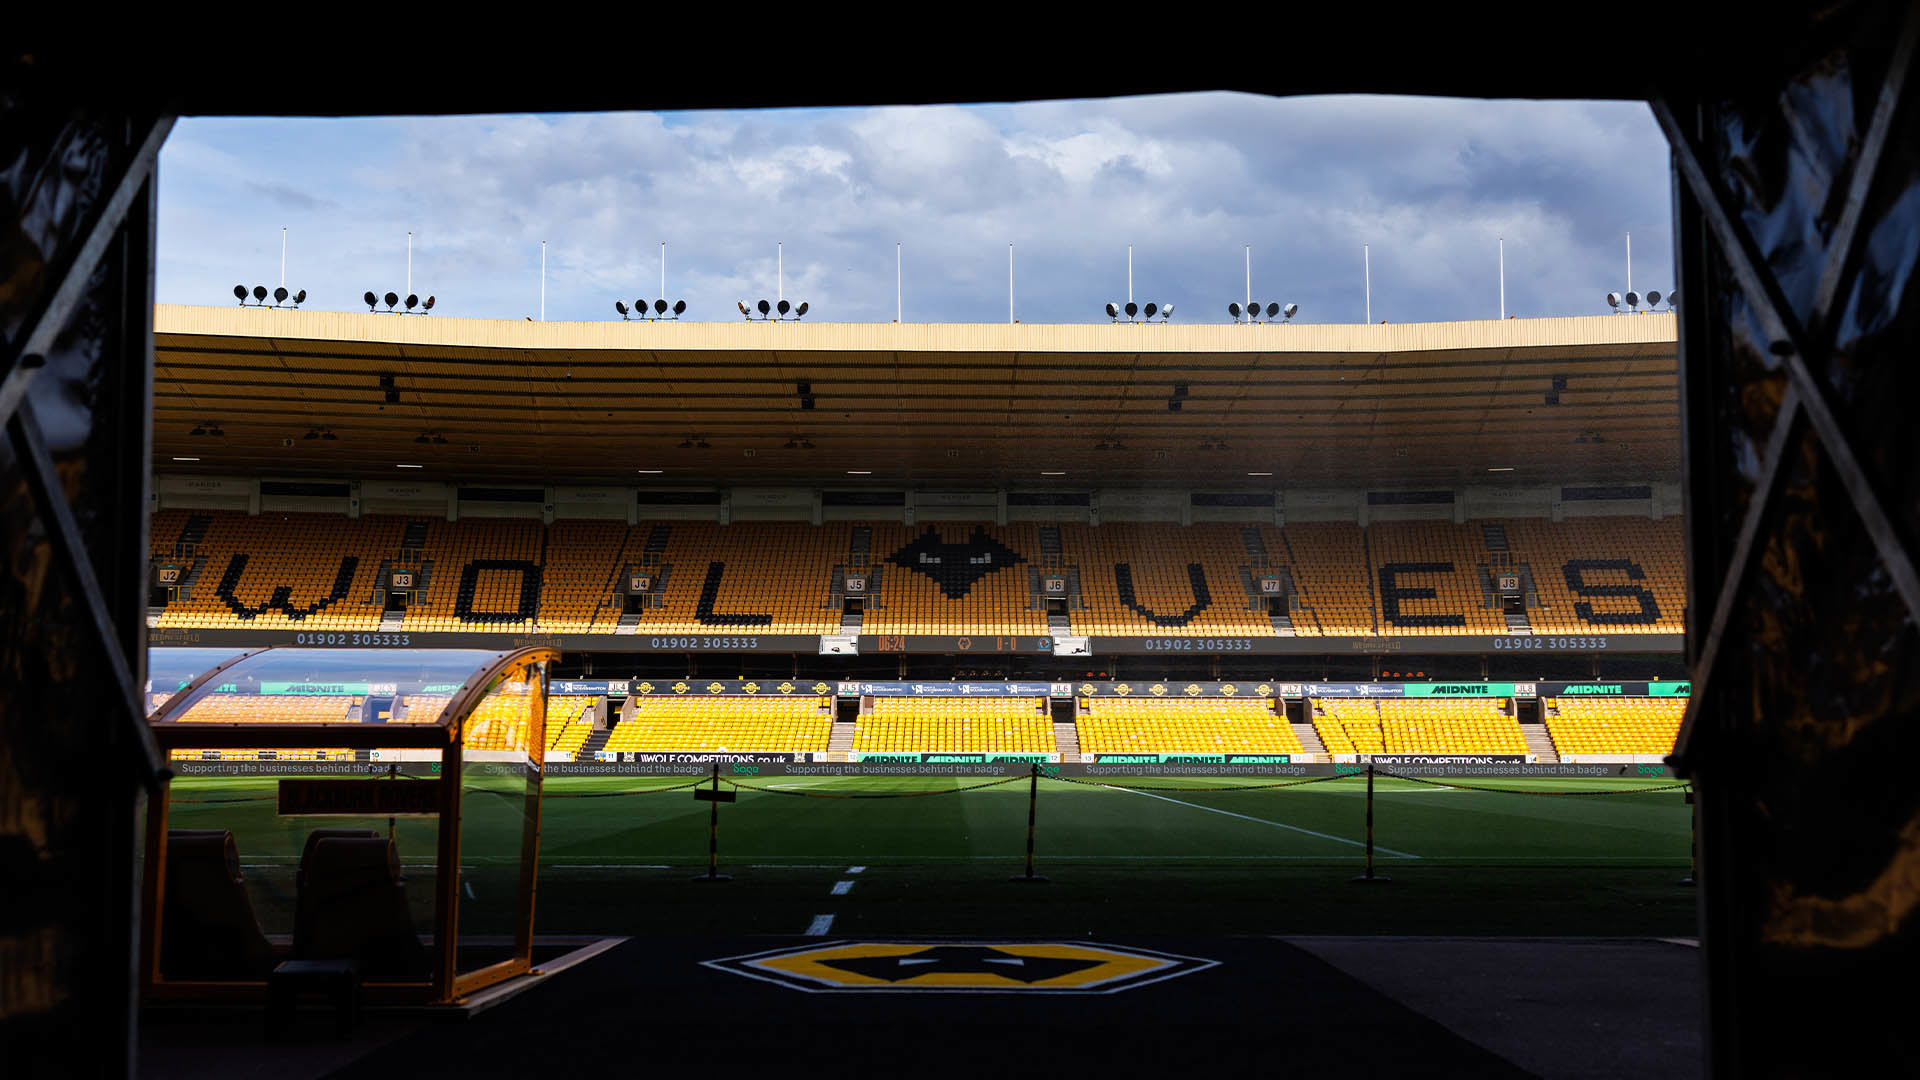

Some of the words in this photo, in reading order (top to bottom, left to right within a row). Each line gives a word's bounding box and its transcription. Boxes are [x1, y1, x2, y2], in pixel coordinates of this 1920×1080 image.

[163, 571, 176, 581] J2
[396, 575, 410, 585] J3
[634, 579, 647, 590] J4
[850, 580, 863, 591] J5
[1049, 580, 1062, 591] J6
[1264, 580, 1277, 591] J7
[1502, 578, 1516, 589] J8
[297, 633, 346, 645] 01902
[352, 633, 411, 645] 305333
[651, 637, 698, 649] 01902
[703, 637, 758, 649] 305333
[878, 635, 905, 651] 06:24
[1145, 639, 1192, 650] 01902
[1197, 639, 1252, 650] 305333
[1494, 638, 1543, 649] 01902
[1549, 638, 1607, 649] 305333
[1431, 685, 1488, 694] MIDNITE
[1563, 685, 1622, 694] MIDNITE
[1097, 756, 1157, 764] MIDNITE
[182, 763, 239, 775] Supporting
[240, 764, 258, 773] the
[260, 763, 315, 773] businesses
[316, 763, 350, 773] behind
[352, 763, 369, 773] the
[371, 763, 403, 775] bade
[543, 763, 558, 773] the
[561, 763, 616, 773] businesses
[618, 763, 653, 773] behind
[655, 763, 671, 773] the
[673, 763, 704, 775] badge
[785, 764, 843, 776] Supporting
[844, 764, 861, 773] the
[863, 764, 919, 774] businesses
[919, 764, 954, 774] behind
[955, 764, 972, 774] the
[974, 764, 1006, 776] badge
[1086, 764, 1144, 776] Supporting
[1145, 764, 1161, 774] the
[1163, 764, 1218, 774] businesses
[1219, 764, 1255, 774] behind
[1256, 764, 1273, 774] the
[1275, 764, 1306, 776] badge
[1387, 764, 1445, 776] Supporting
[1446, 764, 1464, 774] the
[1465, 764, 1520, 774] businesses
[1522, 764, 1557, 774] behind
[1559, 764, 1575, 774] the
[1577, 764, 1608, 776] badge
